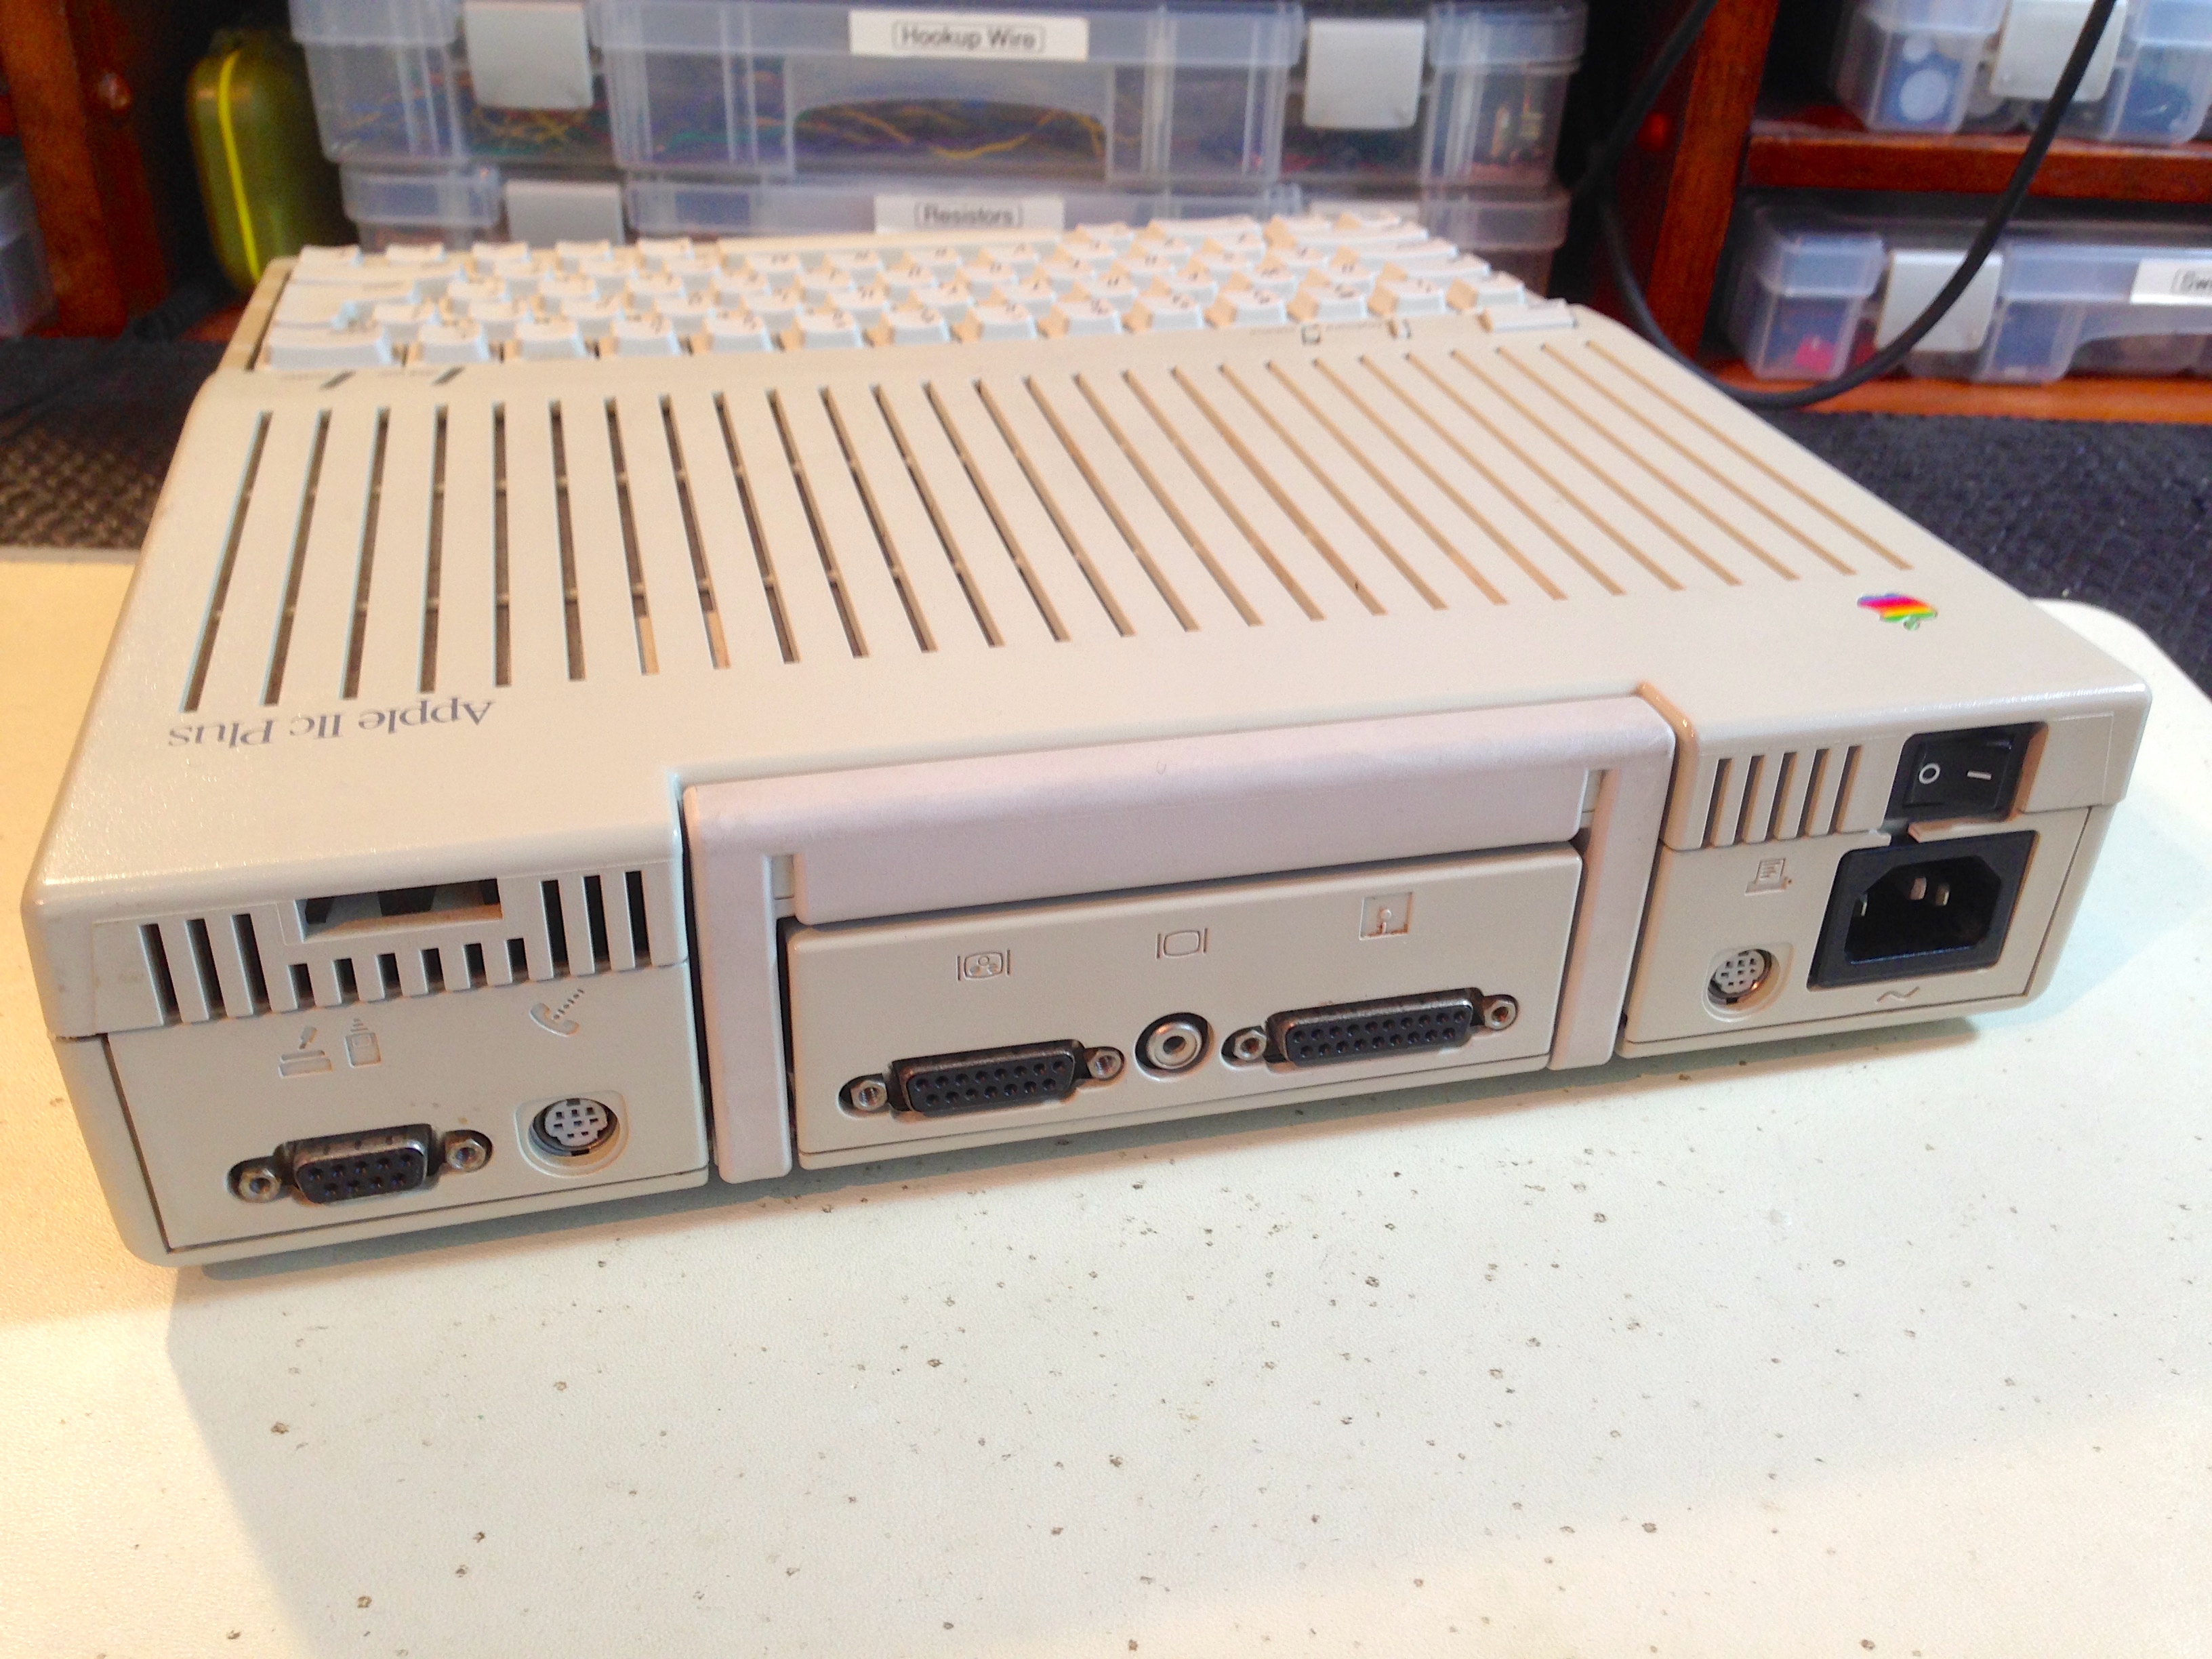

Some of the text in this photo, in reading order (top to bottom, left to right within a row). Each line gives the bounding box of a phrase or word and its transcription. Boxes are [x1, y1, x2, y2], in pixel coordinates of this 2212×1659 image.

[901, 25, 1036, 51] Hookup Wire
[924, 203, 1014, 225] Resistors
[167, 696, 495, 749] Apple IIc Plus
